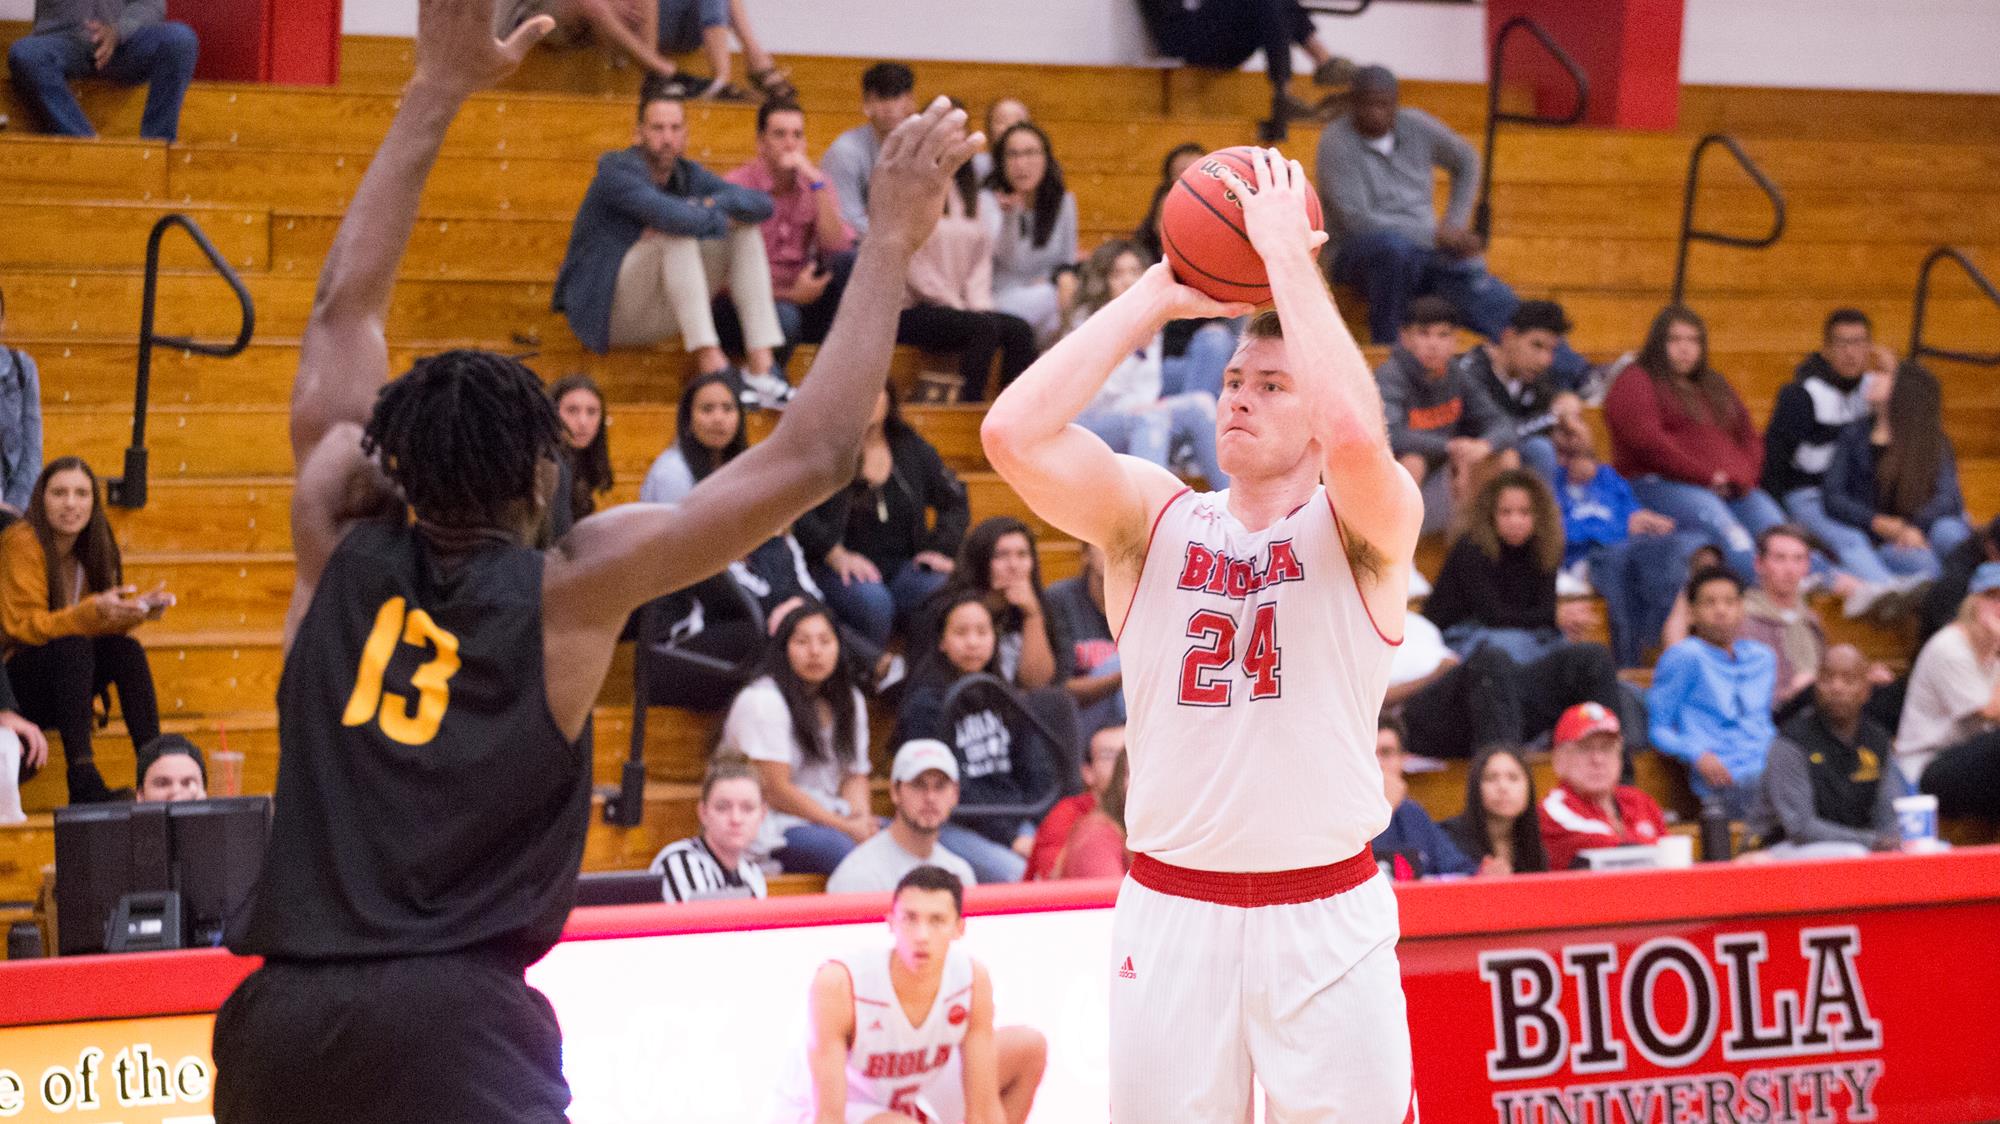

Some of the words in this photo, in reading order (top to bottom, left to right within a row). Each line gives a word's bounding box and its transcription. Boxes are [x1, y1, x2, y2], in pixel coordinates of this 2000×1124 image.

[1177, 537, 1305, 600] BIOLA
[340, 595, 462, 746] 13
[1178, 601, 1282, 707] 24
[1480, 928, 1881, 1079] BIOLA
[42, 1051, 100, 1108] of
[114, 1048, 206, 1102] the
[1494, 1061, 1882, 1124] UNIVERSITY
